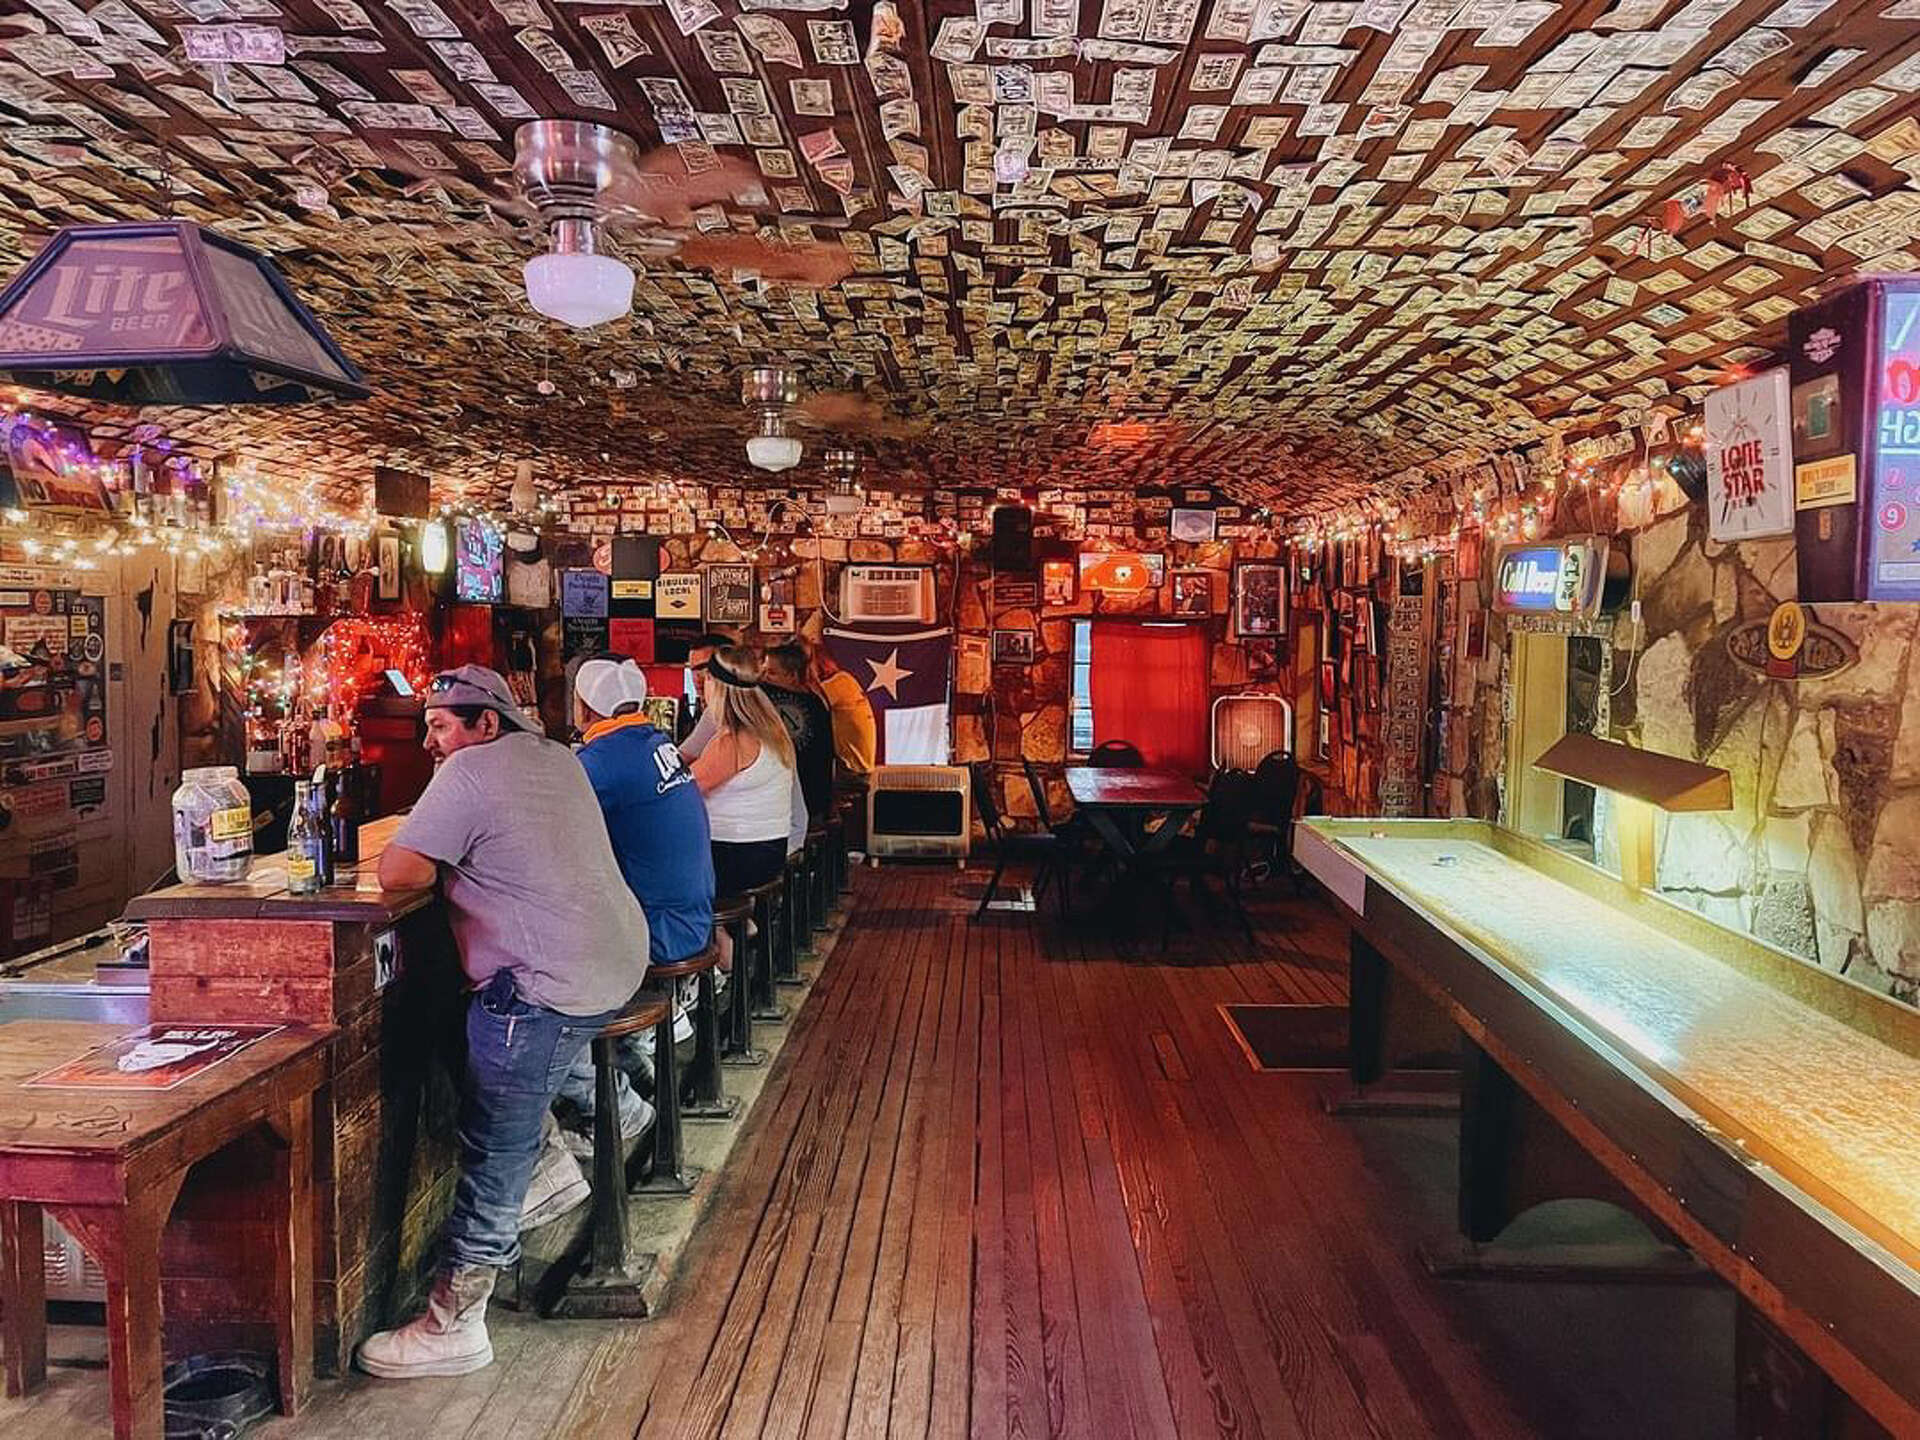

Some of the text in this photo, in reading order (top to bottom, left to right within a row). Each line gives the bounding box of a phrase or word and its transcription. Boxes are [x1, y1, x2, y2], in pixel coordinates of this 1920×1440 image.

[43, 264, 187, 329] Lite
[111, 314, 170, 332] BEER
[1721, 439, 1765, 473] LONE
[1722, 467, 1766, 499] STAR
[663, 585, 691, 596] LOCAL
